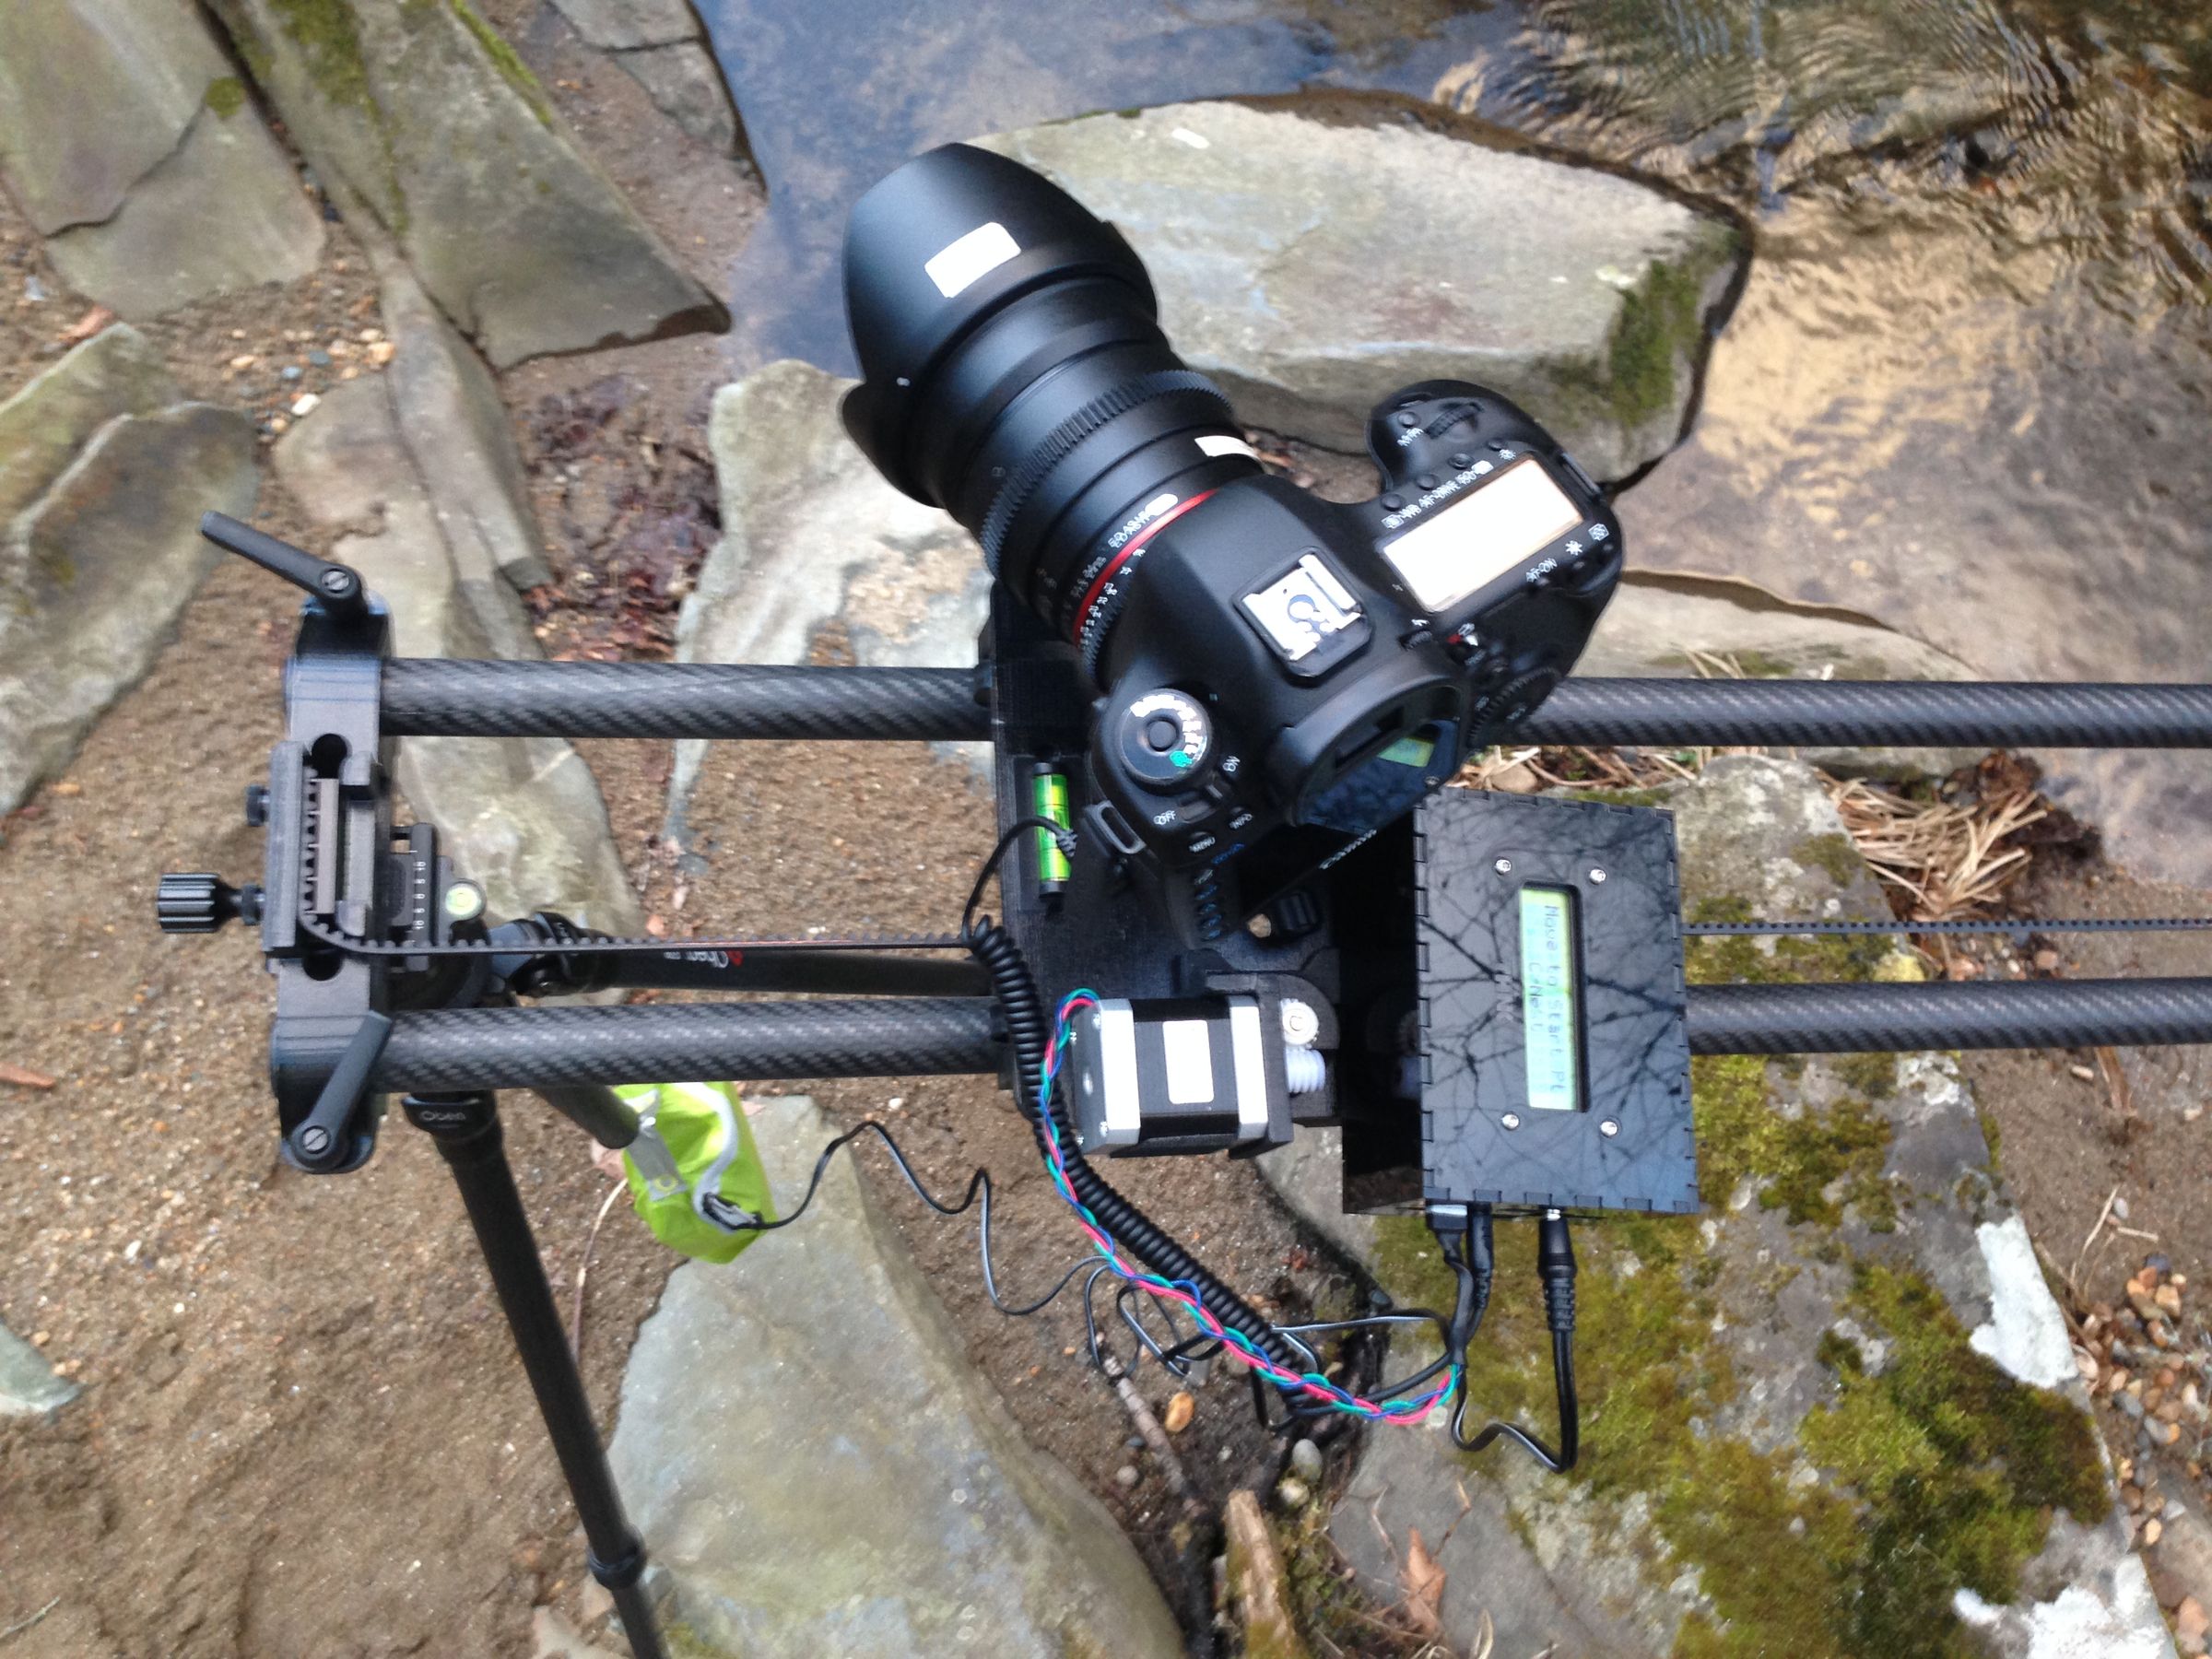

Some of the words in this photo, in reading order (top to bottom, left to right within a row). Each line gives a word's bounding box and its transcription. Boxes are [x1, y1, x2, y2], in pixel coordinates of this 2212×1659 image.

[1222, 756, 1241, 772] ON
[1153, 810, 1176, 825] OFF
[1544, 905, 1559, 950] Move
[1547, 965, 1561, 987] to
[1547, 999, 1564, 1057] Start
